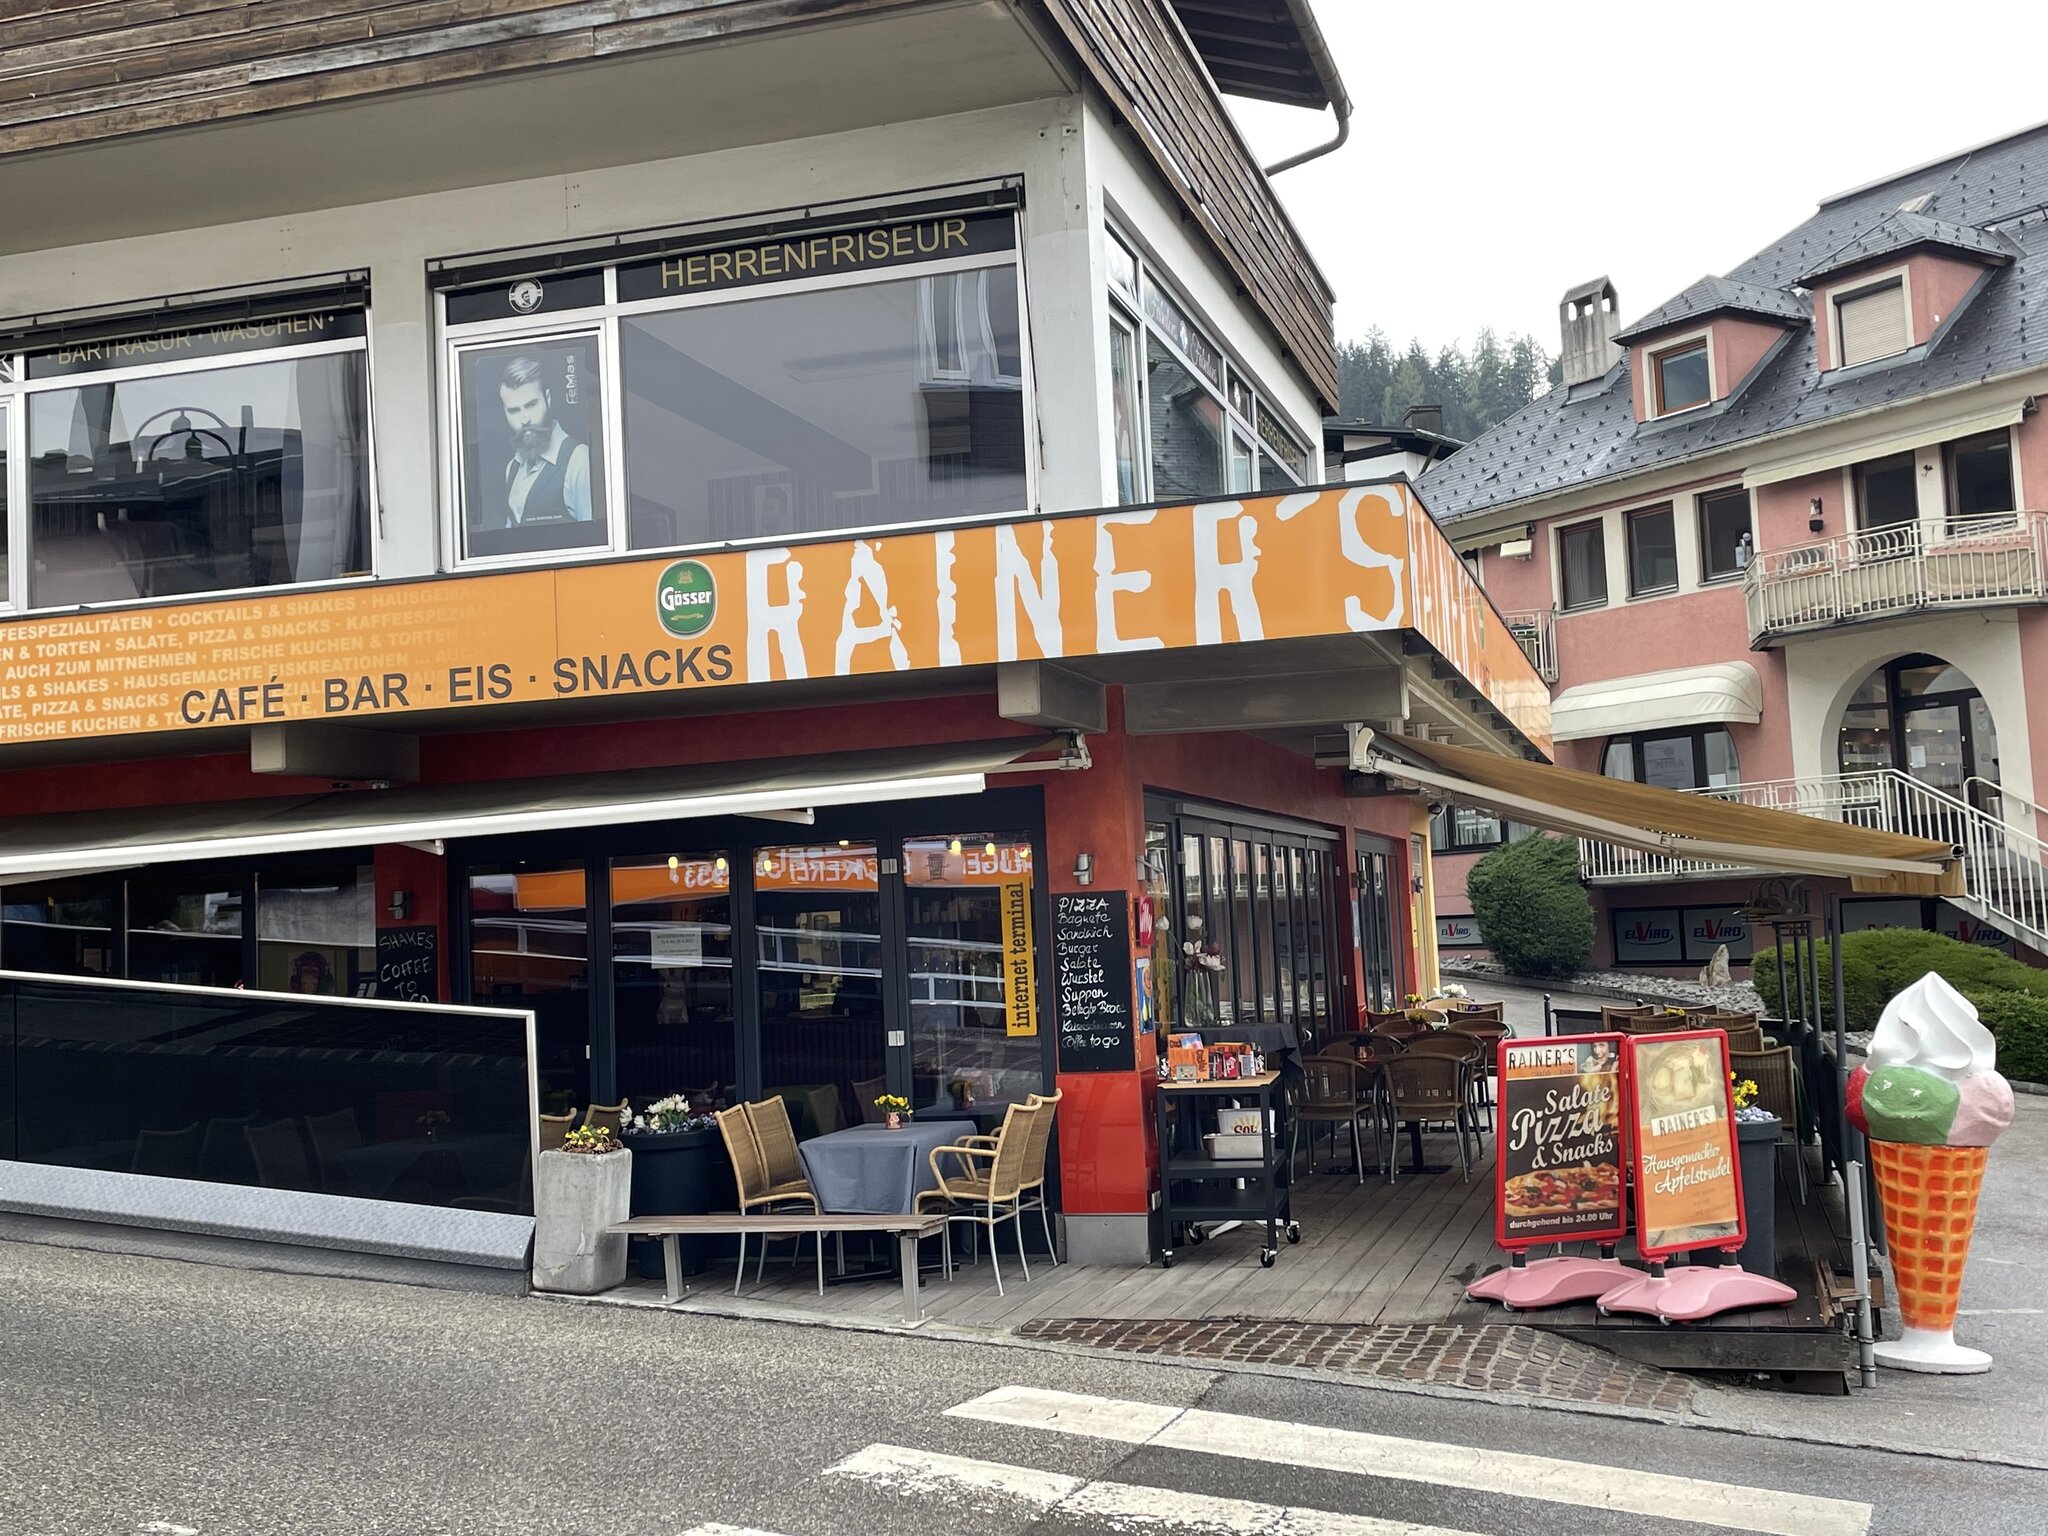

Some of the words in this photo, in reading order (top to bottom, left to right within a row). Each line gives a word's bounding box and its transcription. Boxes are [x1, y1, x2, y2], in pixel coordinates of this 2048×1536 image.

[661, 219, 969, 290] HERRENFRISEUR
[58, 331, 191, 365] BARTRASUR
[211, 311, 324, 345] WASCHEN
[167, 605, 263, 628] COCKTAILS
[269, 604, 281, 618] &
[287, 596, 356, 617] SHAKES
[661, 587, 712, 611] Gösser
[6, 663, 50, 680] AUCH
[55, 660, 91, 676] ZUM
[96, 652, 196, 673] MITNEHMEN
[212, 644, 285, 663] FRISCHE
[290, 636, 363, 656] KUCHEN
[388, 627, 458, 647] TORTEN
[20, 645, 30, 659] &
[36, 640, 101, 659] TORTEN
[188, 628, 237, 646] PIZZA
[243, 626, 255, 641] &
[261, 619, 330, 639] SNACKS
[43, 678, 108, 697] SHAKES
[124, 665, 263, 690] HAUSGEMACHTE
[181, 675, 285, 724] CAFÉ
[324, 673, 410, 713] BAR
[449, 663, 513, 704] EIS
[553, 644, 731, 694] SNACKS
[32, 698, 79, 717] PIZZA
[84, 698, 96, 713] &
[102, 692, 169, 712] SNACKS
[0, 720, 66, 739] FRISCHE
[71, 715, 141, 735] KUCHEN
[1006, 882, 1028, 955] terminal
[1059, 897, 1109, 913] PIZZA
[379, 931, 434, 950] SHAKES
[1057, 925, 1113, 941] Sandwich
[1057, 942, 1098, 958] Burger
[380, 956, 432, 982] COFFEE
[394, 981, 417, 999] TO
[1010, 958, 1031, 1029] internet
[1545, 1084, 1612, 1116] Salate
[1509, 1107, 1603, 1152] Pizza
[1531, 1145, 1547, 1169] &
[1551, 1133, 1613, 1166] Snacks
[1655, 1156, 1731, 1195] Apfelstrudel
[1509, 1216, 1560, 1229] durchgehend
[1562, 1215, 1573, 1224] bis
[1599, 1212, 1613, 1220] Uhr
